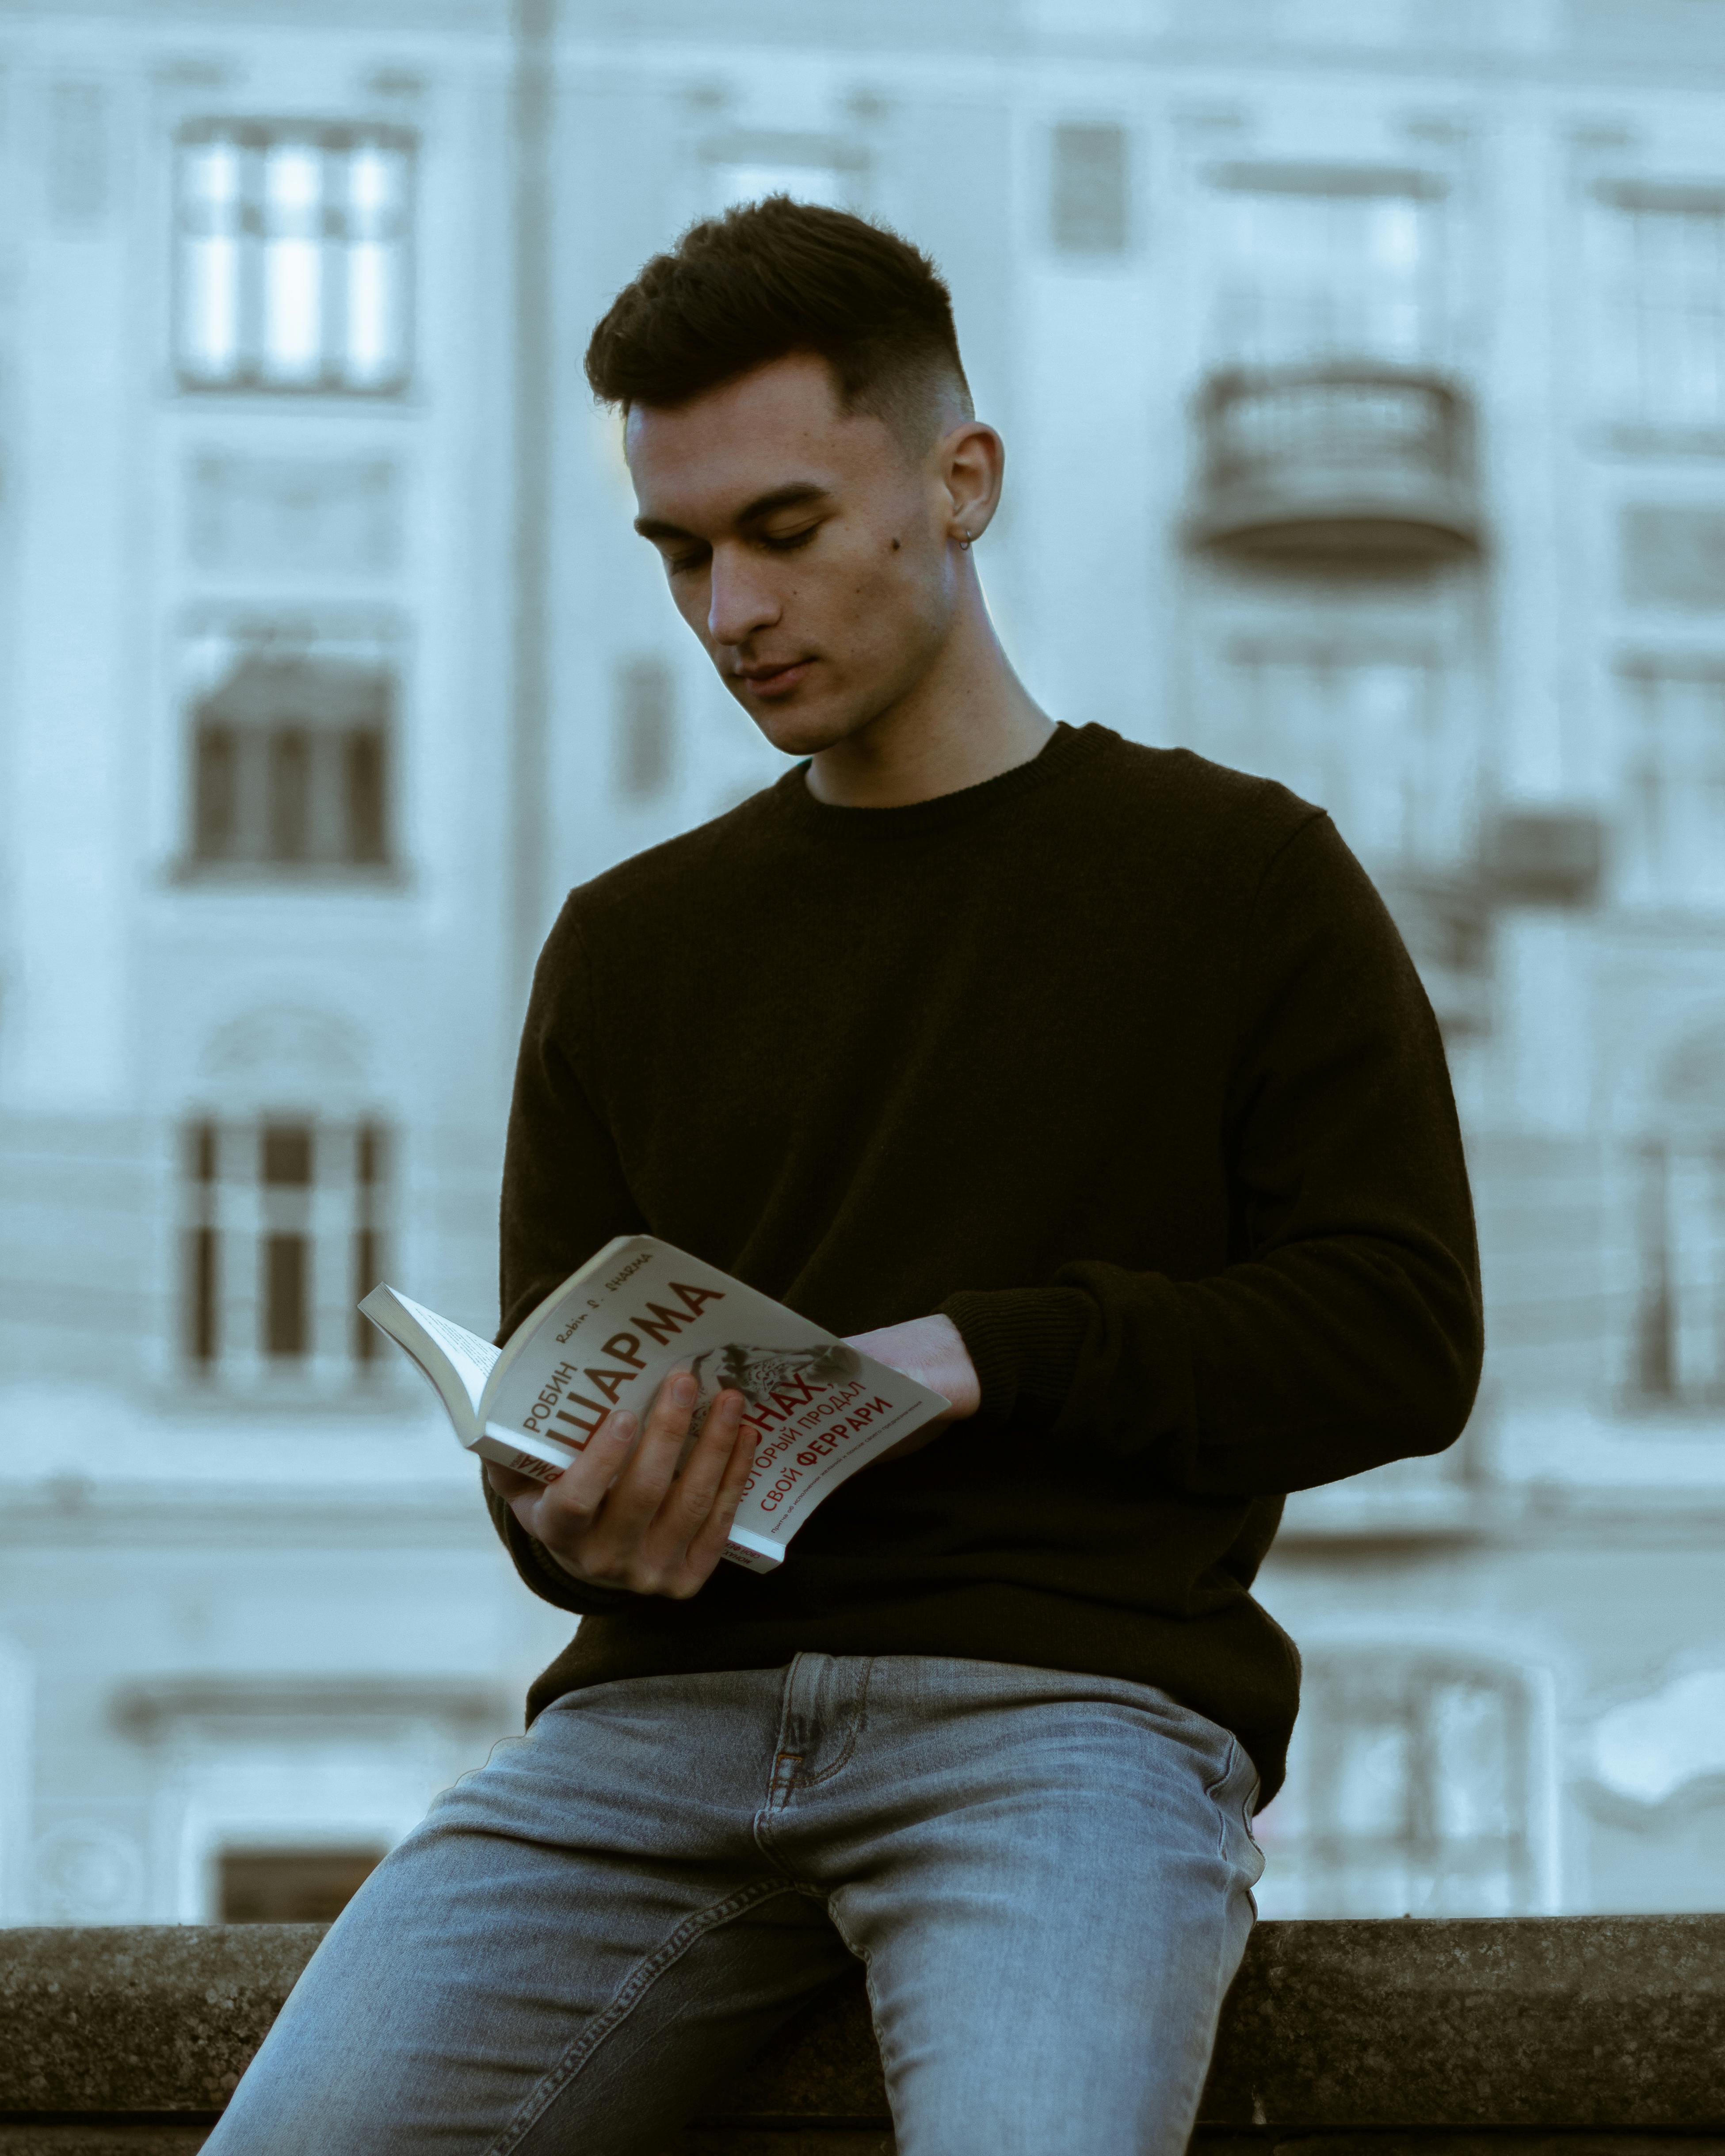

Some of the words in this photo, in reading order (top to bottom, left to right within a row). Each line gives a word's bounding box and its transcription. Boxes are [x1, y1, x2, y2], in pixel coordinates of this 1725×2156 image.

[556, 1313, 588, 1344] Robin
[605, 1253, 653, 1292] SHARMA
[523, 1361, 577, 1433] РОБИН
[544, 1282, 726, 1452] ШАРМА
[738, 1372, 834, 1447] НАХ,
[517, 1455, 565, 1483] РМА
[739, 1425, 803, 1503] ОТОРЫЙ
[798, 1381, 866, 1430] ПРОДАЛ
[760, 1467, 803, 1512] СВОЙ
[796, 1396, 893, 1467] ФЕРРАРИ
[771, 1513, 789, 1534] Притча
[793, 1476, 821, 1505] исполнении
[821, 1458, 843, 1476] желаний
[847, 1442, 865, 1455] поиске
[865, 1430, 882, 1442] своего
